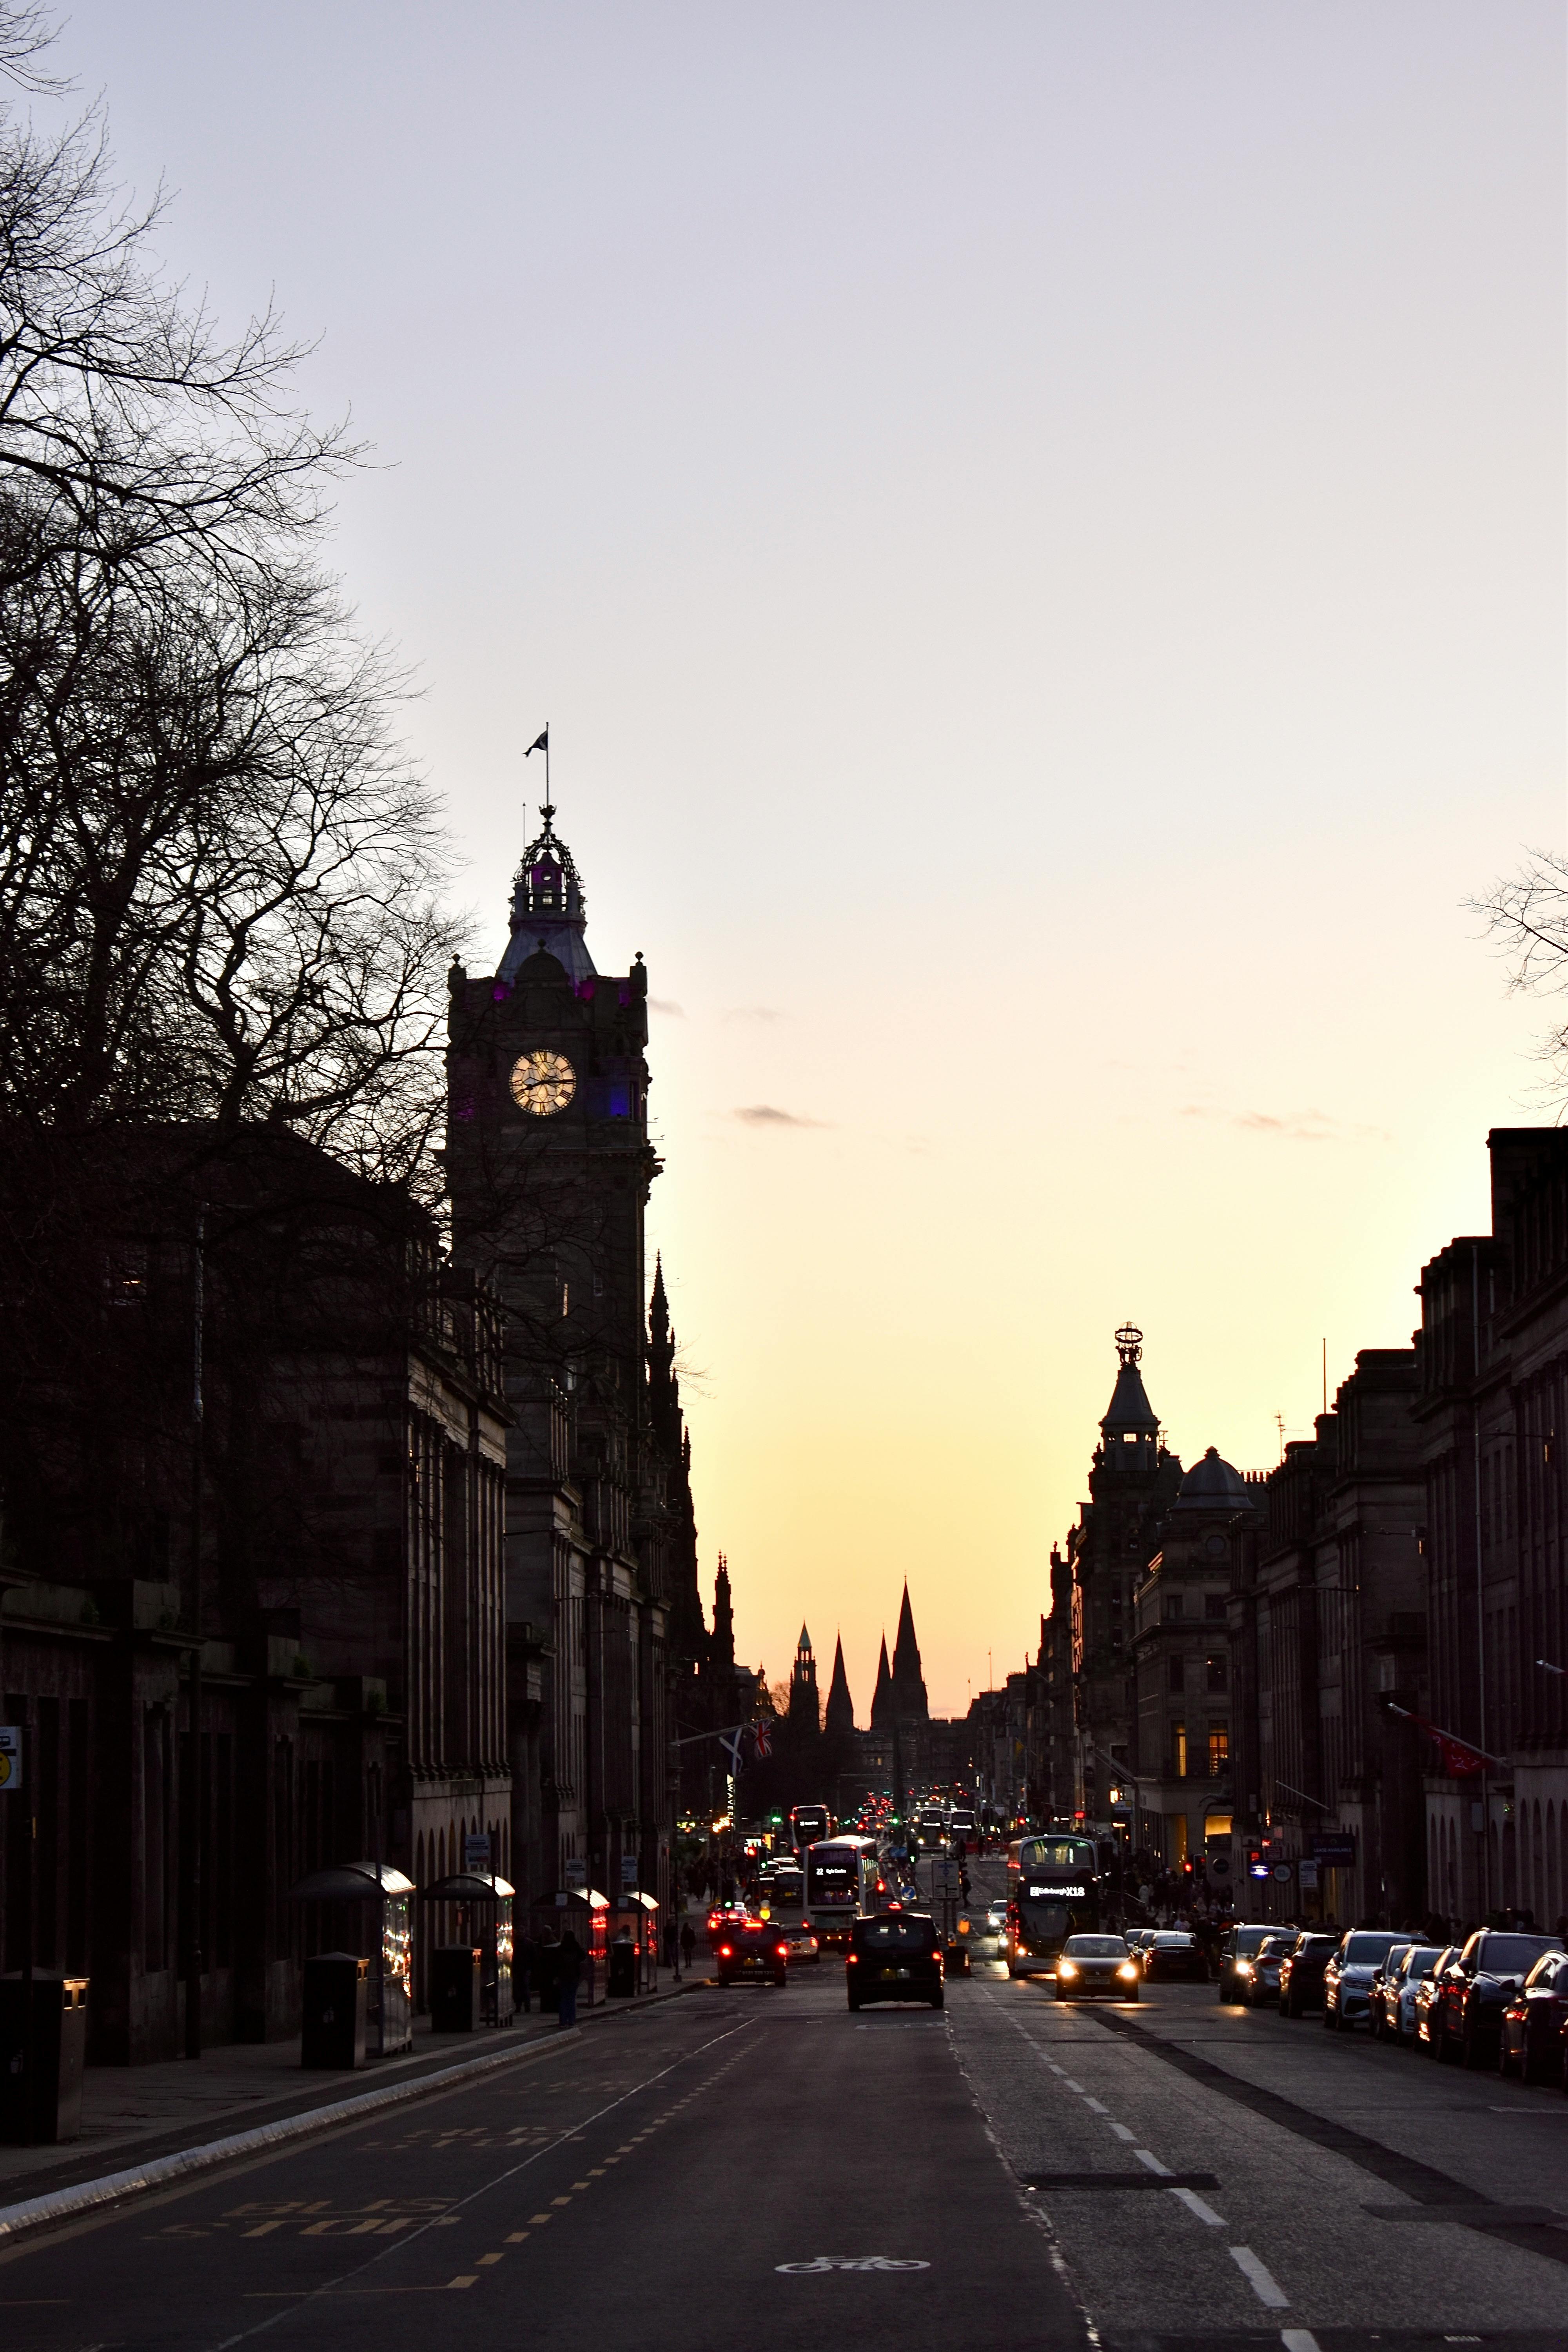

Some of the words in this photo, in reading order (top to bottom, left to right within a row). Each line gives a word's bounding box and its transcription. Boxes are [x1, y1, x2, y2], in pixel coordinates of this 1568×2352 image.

[1066, 1887, 1085, 1896] X18
[220, 2198, 459, 2217] BUS
[140, 2217, 462, 2239] STOP
